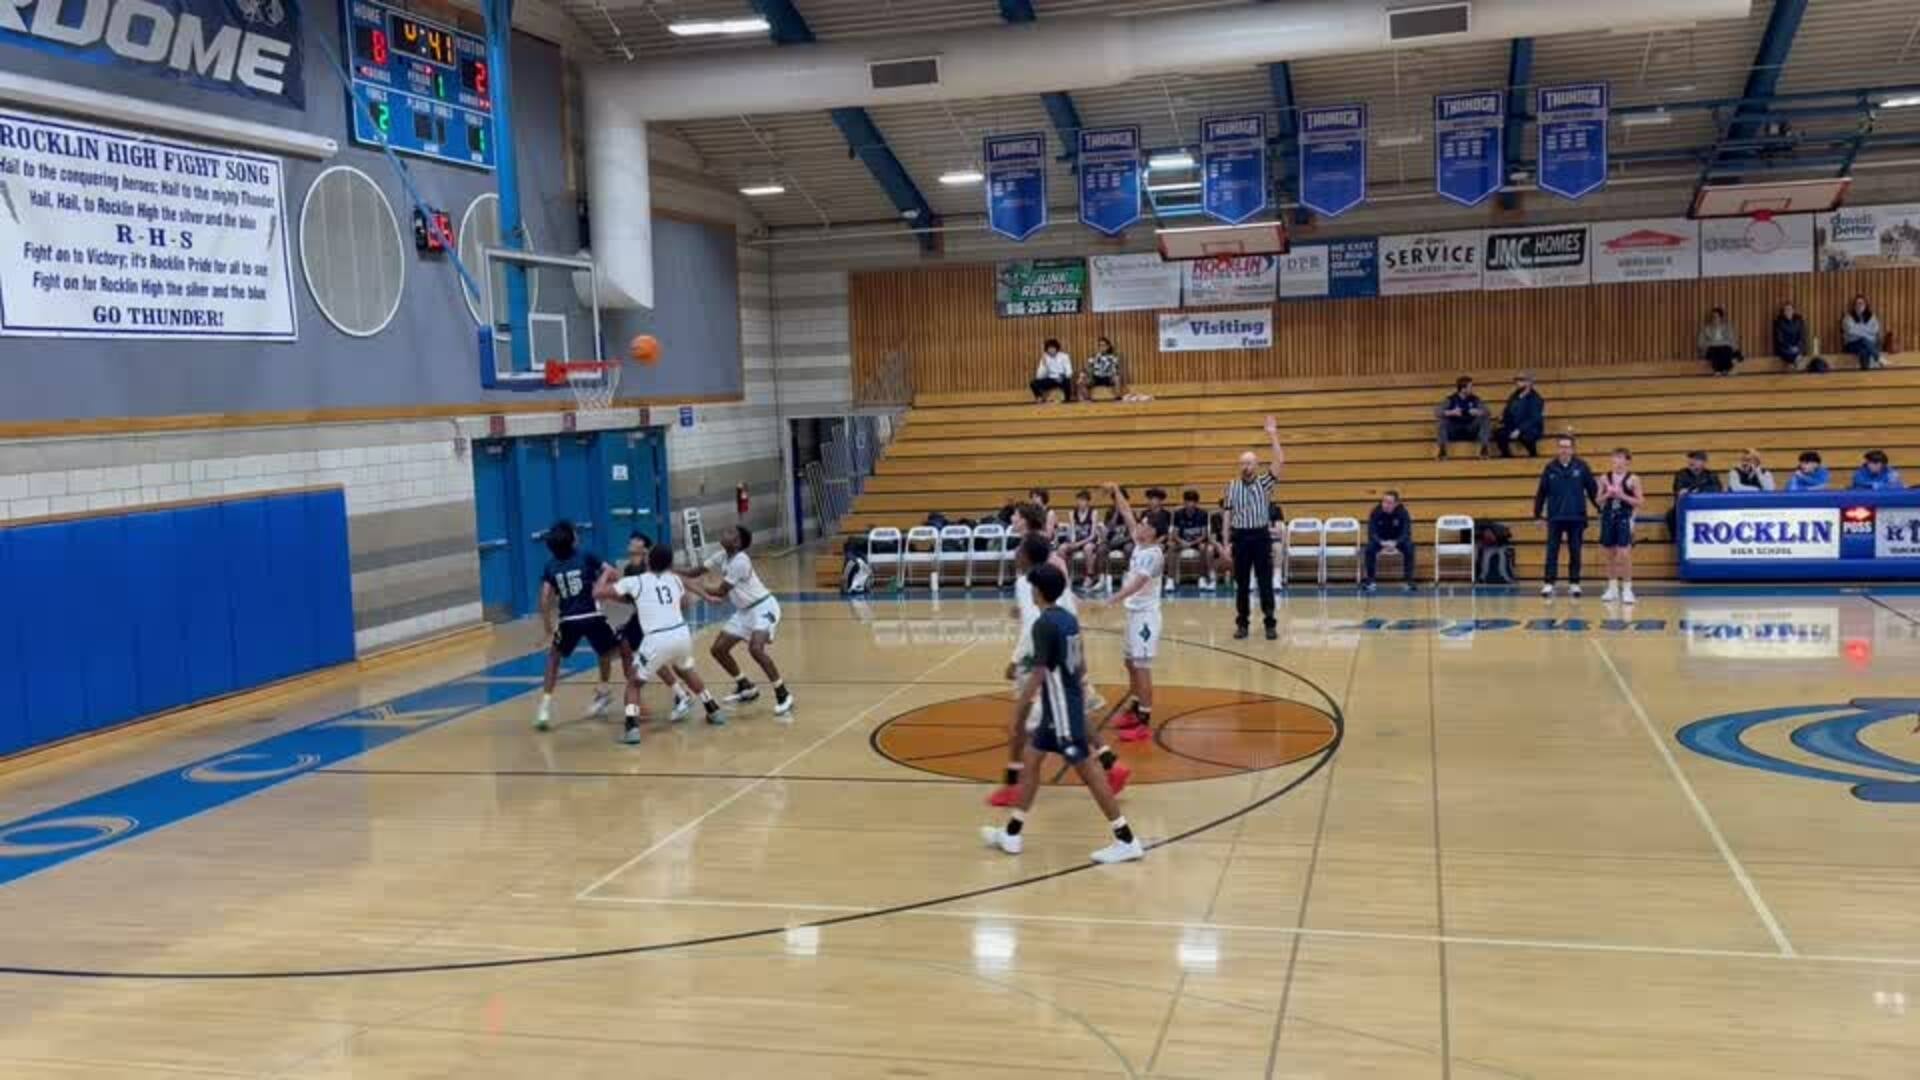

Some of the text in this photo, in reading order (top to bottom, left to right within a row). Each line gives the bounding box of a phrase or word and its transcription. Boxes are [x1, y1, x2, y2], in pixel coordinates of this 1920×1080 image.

[474, 61, 488, 94] 2
[379, 103, 389, 131] 2
[0, 123, 269, 186] ROCKLIN HIGH FIGHT SONG
[23, 160, 35, 176] to
[39, 162, 57, 180] the
[60, 168, 119, 192] conquering
[161, 179, 180, 197] Hail
[181, 183, 192, 199] to
[193, 185, 210, 200] the
[84, 196, 95, 212] to
[98, 197, 135, 216] Rocklin
[138, 201, 159, 222] High
[161, 205, 177, 221] the
[179, 208, 204, 224] silver
[205, 212, 223, 226] and
[224, 213, 238, 227] the
[115, 223, 135, 244] R
[149, 227, 166, 247] H
[180, 230, 193, 249] S
[24, 241, 53, 264] Fight
[55, 248, 71, 262] on
[73, 247, 84, 264] to
[149, 253, 185, 271] Rocklin
[188, 256, 212, 274] Pride
[213, 258, 227, 274] for
[229, 259, 241, 275] all
[242, 260, 252, 275] to
[1192, 254, 1262, 274] ROLIN
[1384, 245, 1476, 269] SERVICE
[1487, 232, 1582, 270] JMC HOMES
[33, 271, 60, 292] Fight
[63, 277, 79, 291] on
[82, 274, 97, 291] for
[100, 275, 138, 294] Rocklin
[141, 279, 164, 299] High
[166, 282, 183, 297] the
[185, 281, 209, 297] silver
[212, 283, 229, 299] and
[230, 283, 245, 299] the
[1021, 284, 1082, 298] REMOVAL
[93, 305, 225, 327] GO THUNDER!
[1190, 320, 1265, 337] Visiting
[1692, 521, 1834, 545] ROCKLIN
[1729, 547, 1793, 556] HIGH SCHOOL
[555, 569, 584, 599] 15
[655, 577, 673, 605] 13
